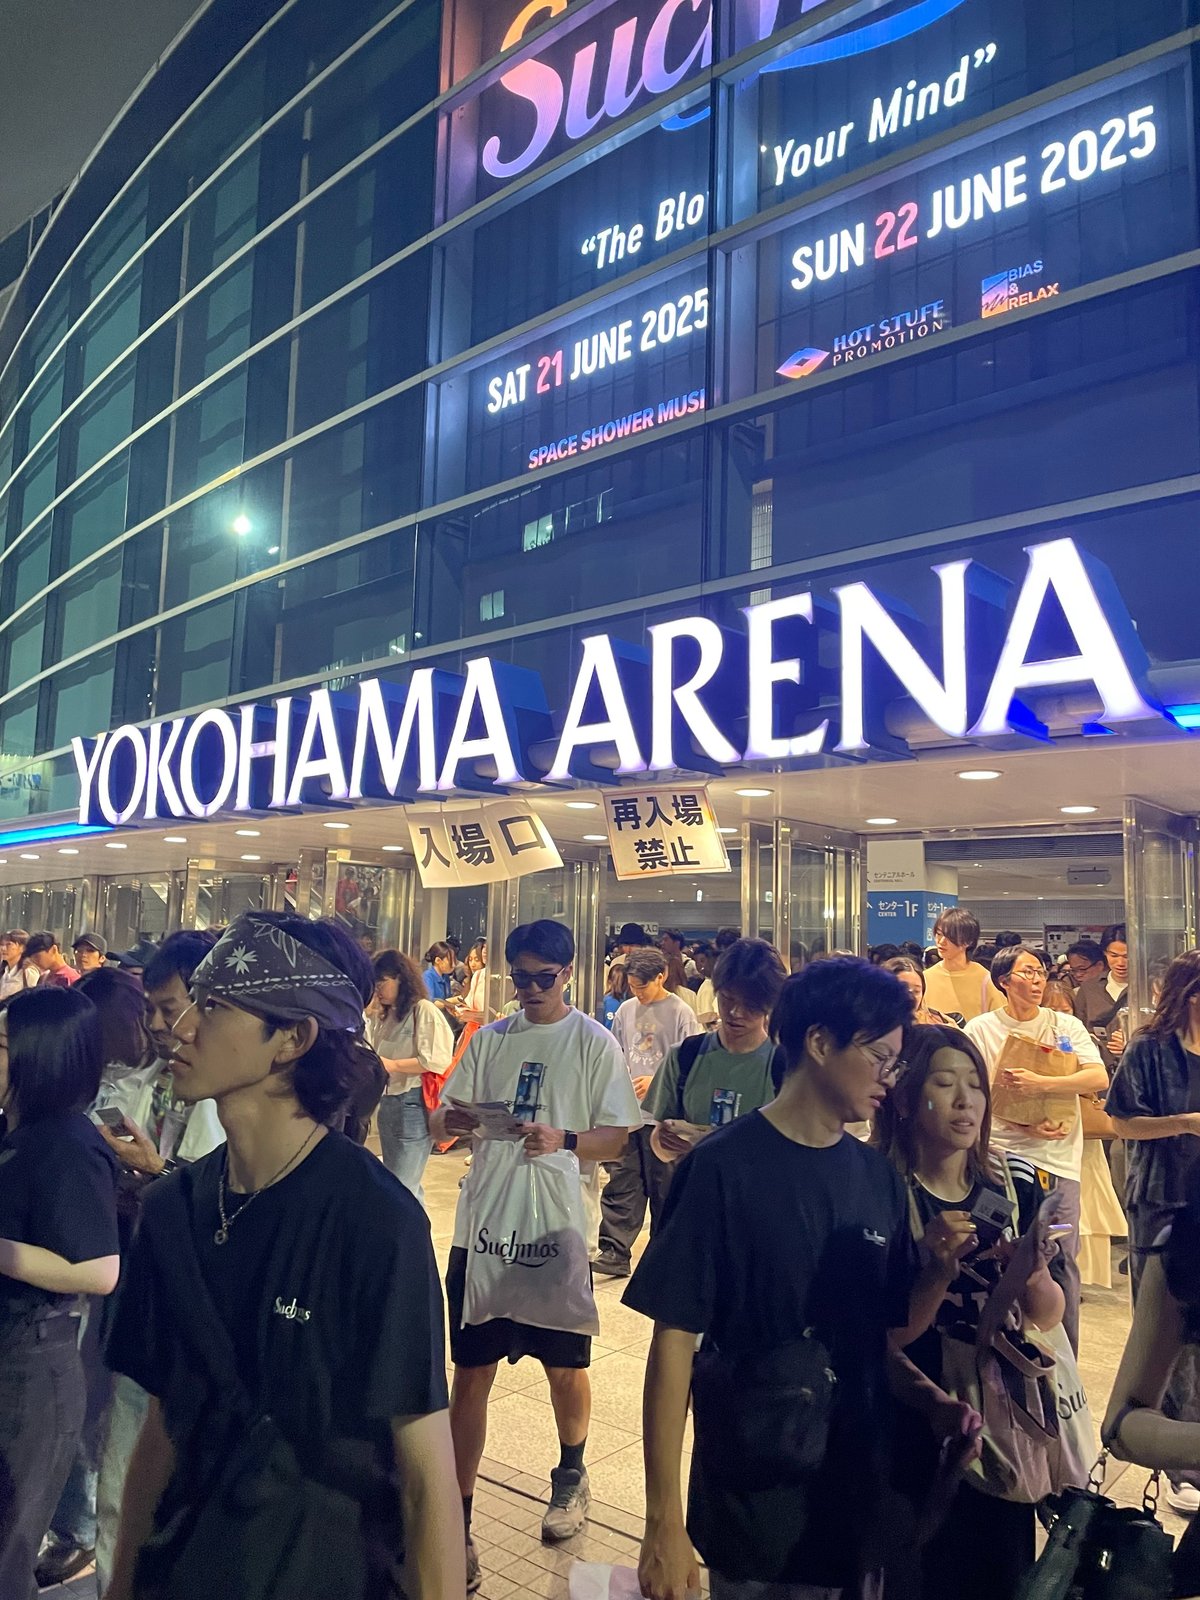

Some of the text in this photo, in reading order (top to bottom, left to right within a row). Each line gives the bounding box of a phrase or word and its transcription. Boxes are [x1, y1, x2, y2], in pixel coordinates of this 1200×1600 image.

[772, 122, 854, 187] Your
[790, 105, 1157, 291] SUN 22 JUNE 2025
[1008, 260, 1044, 282] BIAS
[1008, 283, 1019, 295] &
[1008, 283, 1059, 310] RELAX
[487, 287, 709, 413] SAT 21 JUNE 2025
[832, 320, 944, 367] PROMOTION
[833, 299, 944, 353] HOT STUFF
[528, 434, 577, 469] SPACE
[581, 407, 654, 451] SHOWER
[72, 537, 1163, 826] YOKOHAMA ARENA
[610, 794, 704, 832] 再入場
[419, 815, 547, 869] 入場口
[634, 836, 701, 871] 禁止
[474, 1227, 561, 1268] Suchmos
